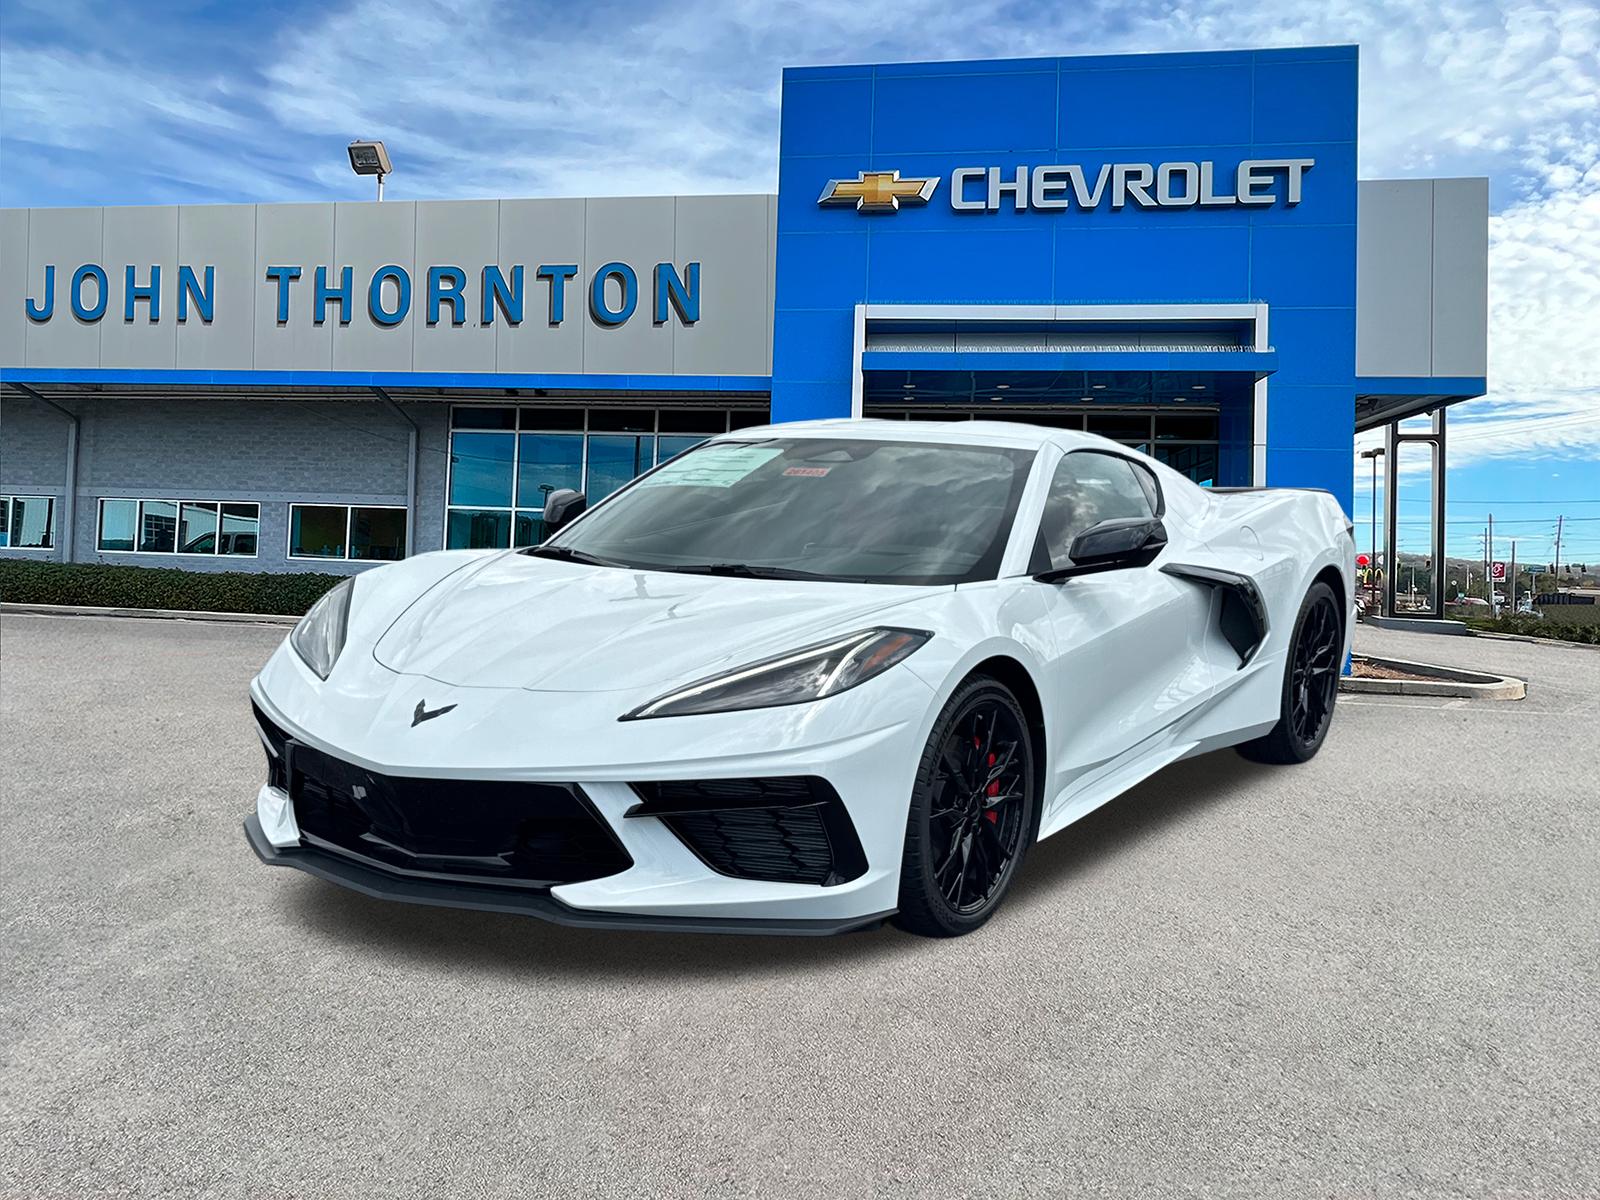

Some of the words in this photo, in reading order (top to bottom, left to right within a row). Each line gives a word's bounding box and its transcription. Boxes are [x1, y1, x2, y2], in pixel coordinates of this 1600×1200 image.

[950, 158, 1315, 213] CHEVROLET
[26, 263, 216, 324] JOHN
[266, 261, 701, 327] THORNTON
